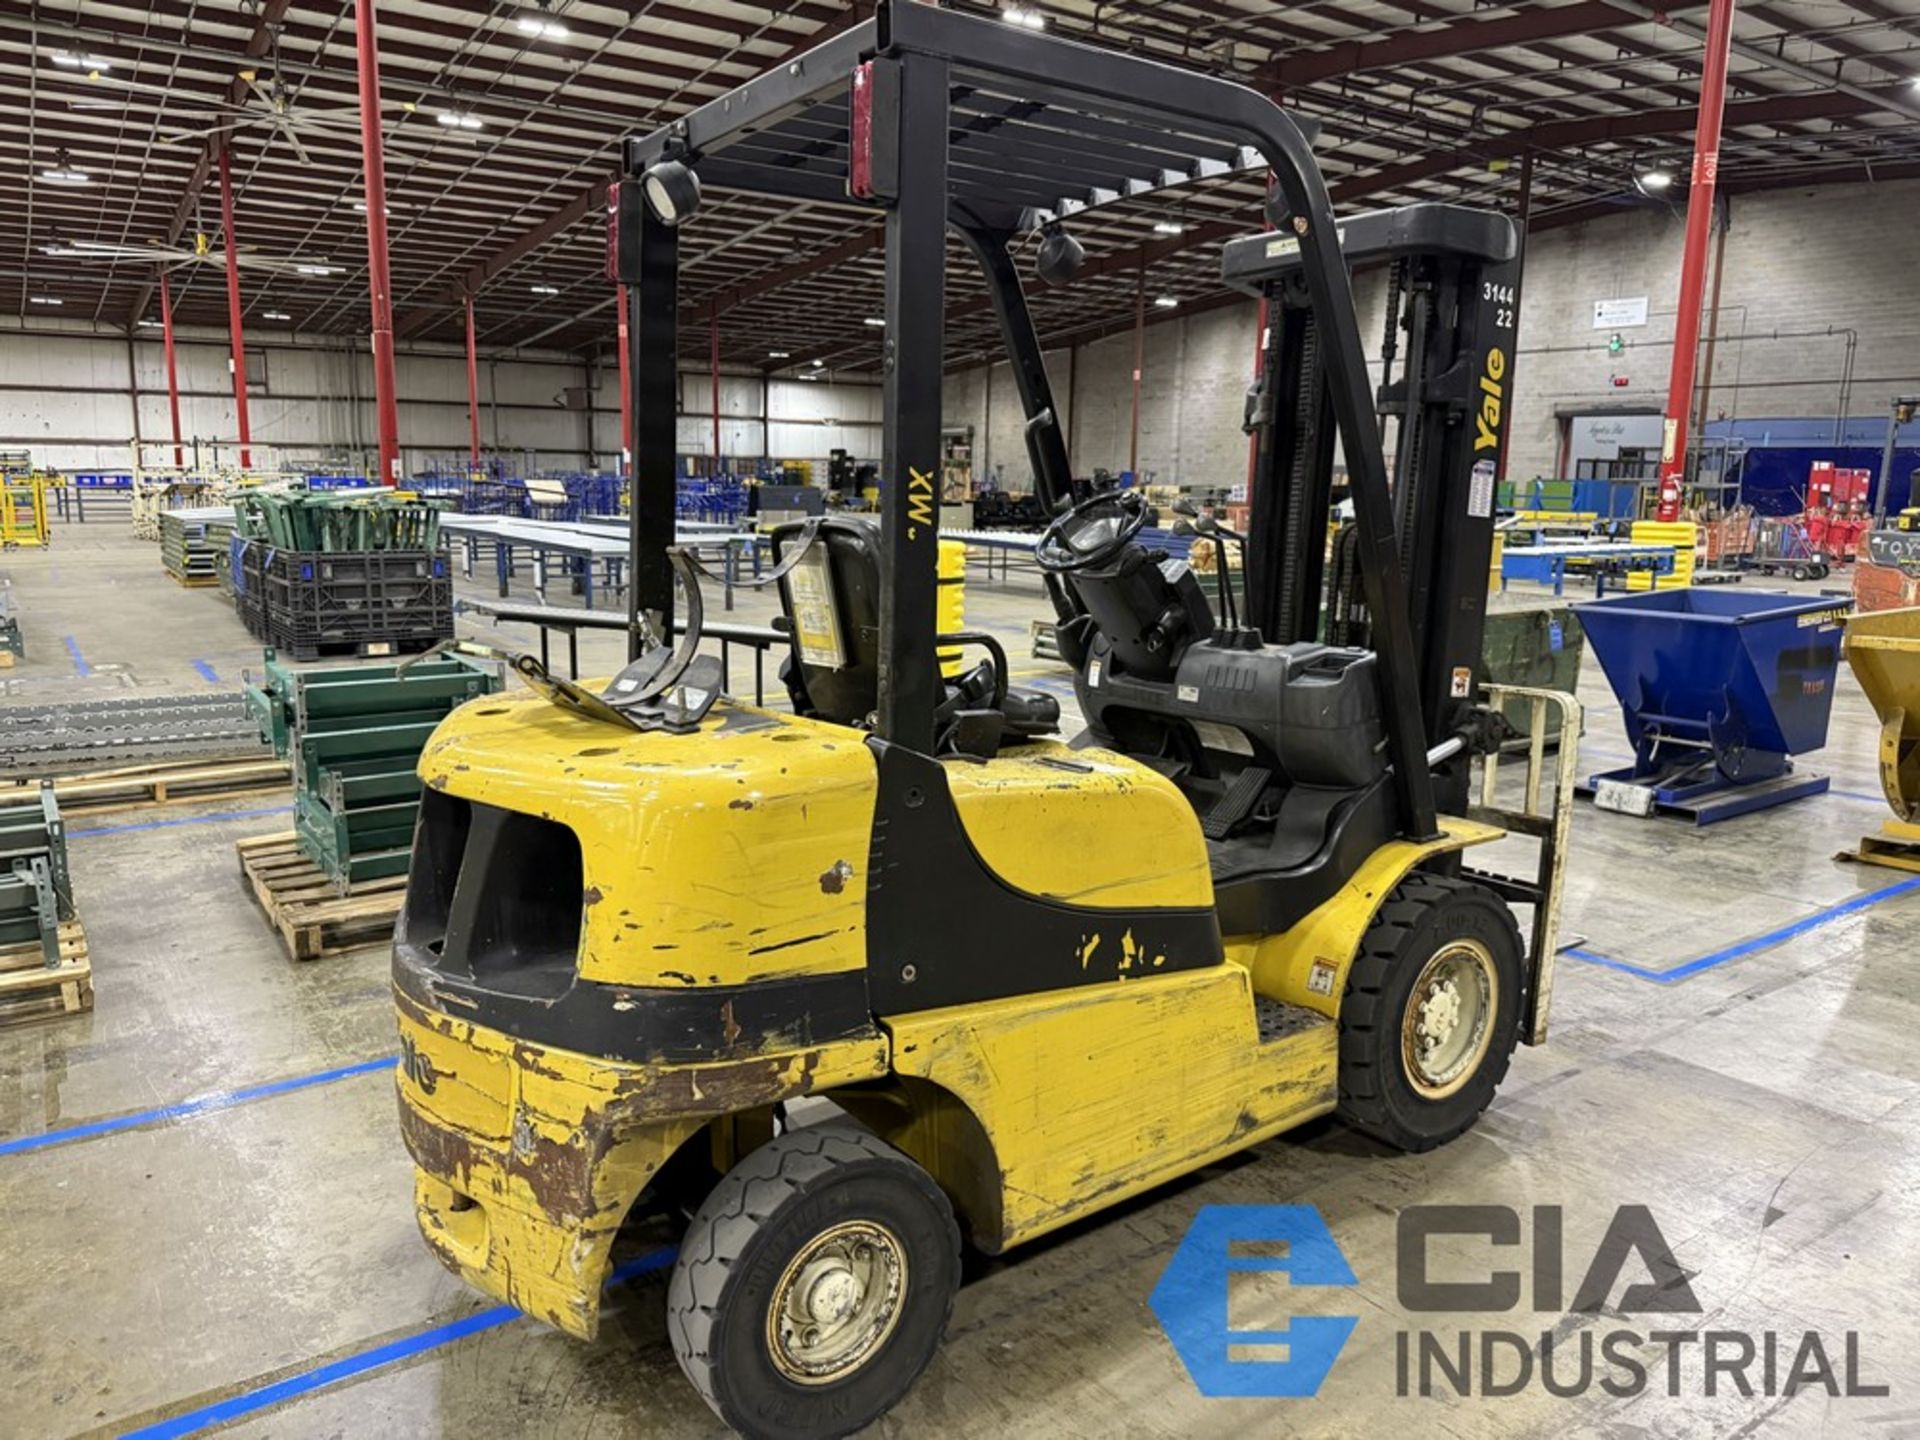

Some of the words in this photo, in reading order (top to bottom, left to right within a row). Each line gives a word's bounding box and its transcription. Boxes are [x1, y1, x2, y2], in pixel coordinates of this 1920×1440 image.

[1483, 282, 1514, 304] 3144
[1496, 309, 1513, 328] 22
[1474, 347, 1506, 451] Yale
